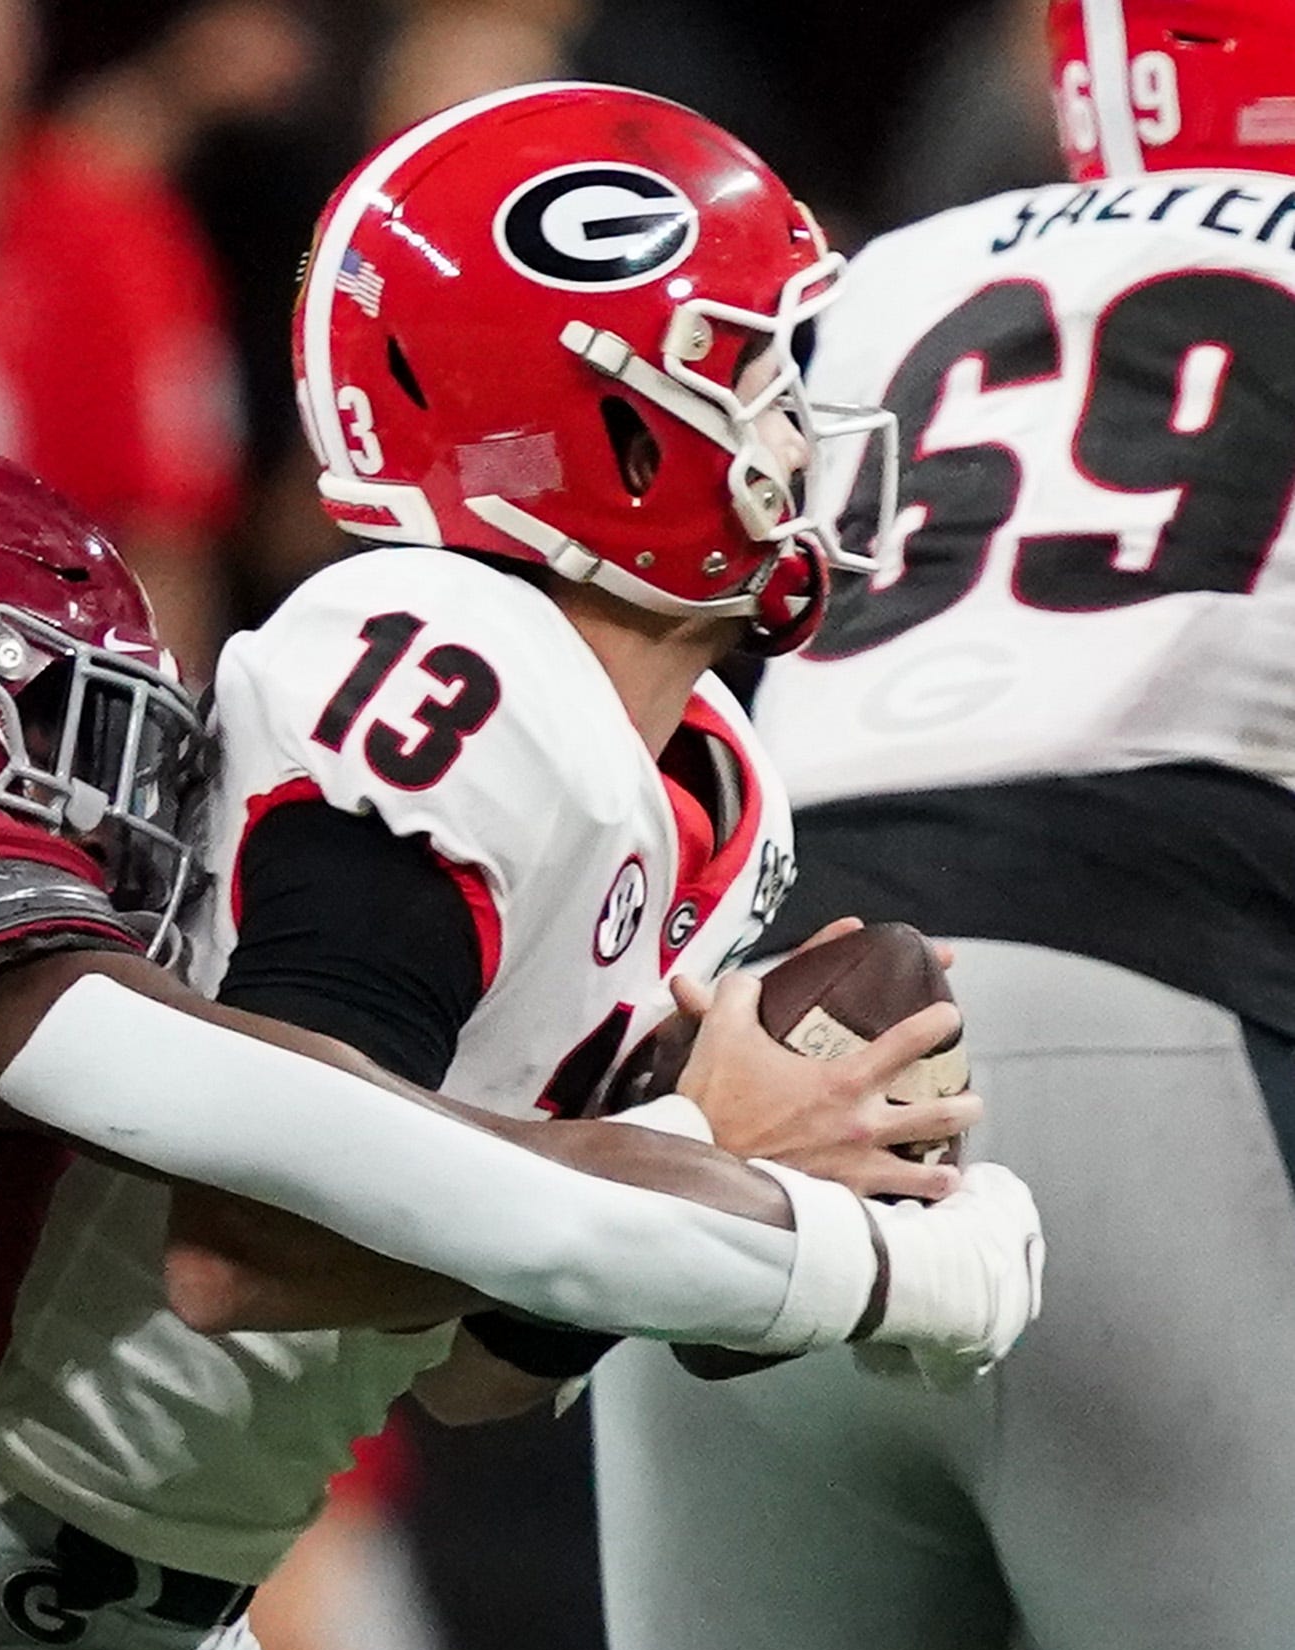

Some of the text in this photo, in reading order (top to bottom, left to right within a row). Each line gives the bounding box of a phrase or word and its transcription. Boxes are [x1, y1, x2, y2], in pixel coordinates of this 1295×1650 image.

[493, 161, 699, 292] G
[794, 267, 1295, 662] 69
[309, 611, 502, 793] 13
[666, 899, 699, 951] G
